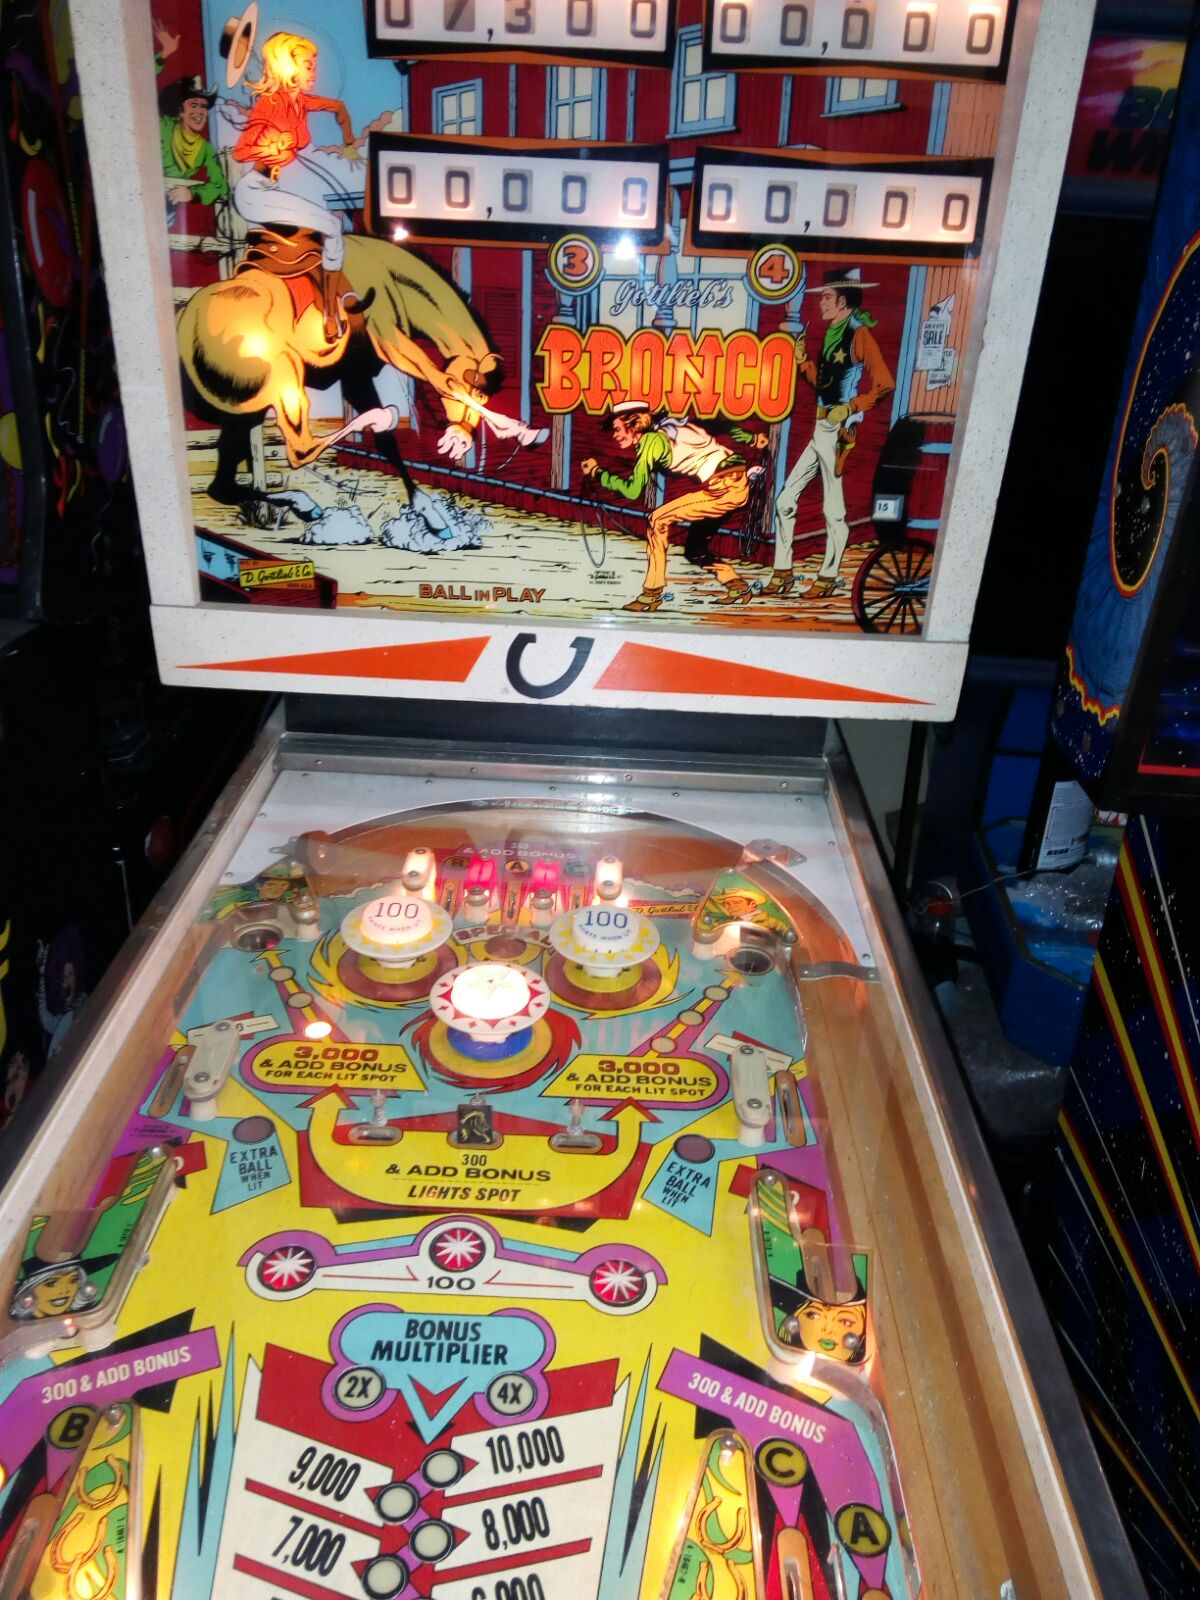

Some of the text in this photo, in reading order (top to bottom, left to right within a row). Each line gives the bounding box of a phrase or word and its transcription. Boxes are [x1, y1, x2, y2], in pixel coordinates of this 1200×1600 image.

[562, 245, 589, 276] 3
[758, 254, 790, 284] 4
[609, 279, 734, 316] Gottlieb's
[922, 330, 943, 346] SALE
[537, 326, 796, 420] BRONCO
[418, 583, 546, 603] BALL IN PLAY
[509, 861, 524, 871] A
[375, 902, 419, 919] 100
[584, 910, 628, 929] 100
[293, 1046, 379, 1062] 3,000
[259, 1059, 408, 1073] & ADD BONUS
[597, 1060, 680, 1075] 3,000
[265, 1070, 397, 1082] FOR EACH LIT SPOT
[566, 1073, 712, 1087] & ADD BONUS
[575, 1084, 706, 1097] FOR EACH LIT SPOT
[229, 1145, 278, 1164] EXTRA
[461, 1154, 488, 1167] 300
[238, 1159, 273, 1175] BALL
[385, 1163, 551, 1182] & ADD BONUS
[666, 1161, 711, 1188] EXTRA
[240, 1171, 271, 1183] WHEN
[248, 1181, 263, 1191] LIT
[666, 1175, 695, 1197] BALL
[408, 1185, 521, 1202] LIGHTS SPOT
[661, 1195, 679, 1208] LIT
[662, 1186, 690, 1204] WHEN
[426, 1276, 476, 1291] 100
[405, 1318, 482, 1342] BONUS
[370, 1340, 508, 1366] MULTIPLIER
[41, 1346, 192, 1404] 300 & ADD BONUS
[343, 1375, 373, 1399] 2X
[496, 1382, 524, 1405] 4X
[687, 1372, 827, 1444] 300 & ADD BONUS
[59, 1412, 91, 1443] B
[485, 1425, 565, 1475] 10,000
[765, 1446, 797, 1479] C
[288, 1446, 362, 1502] 9,000
[481, 1496, 550, 1551] 8,000
[849, 1511, 881, 1546] A
[271, 1515, 346, 1577] 7,000
